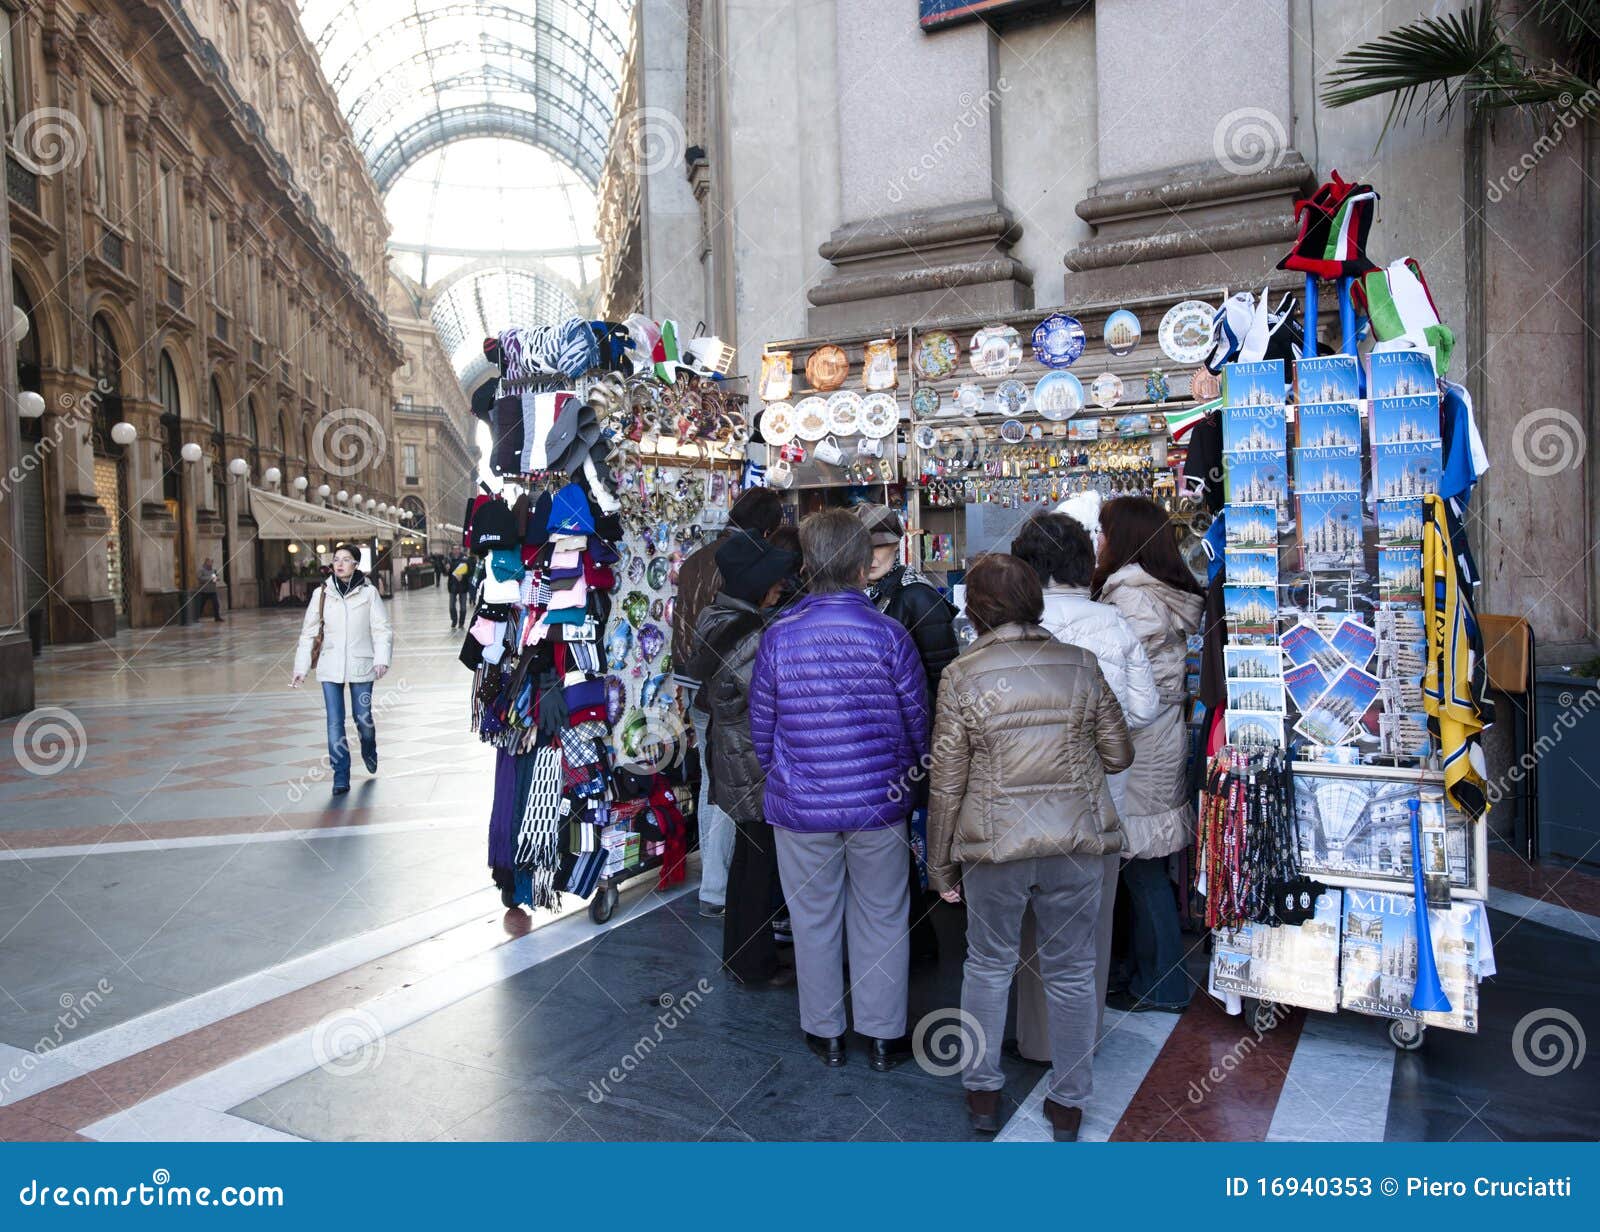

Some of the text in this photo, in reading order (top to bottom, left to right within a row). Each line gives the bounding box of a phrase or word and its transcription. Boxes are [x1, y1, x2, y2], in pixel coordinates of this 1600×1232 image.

[1378, 353, 1425, 364] MILAN
[1234, 362, 1278, 375] MILAN
[1301, 359, 1354, 371] MILANO
[1381, 397, 1431, 409] MILAN
[1302, 404, 1356, 416] MILANO
[1384, 443, 1433, 455] MILAN
[1304, 493, 1358, 504] MILANO
[1384, 551, 1421, 562] MILA
